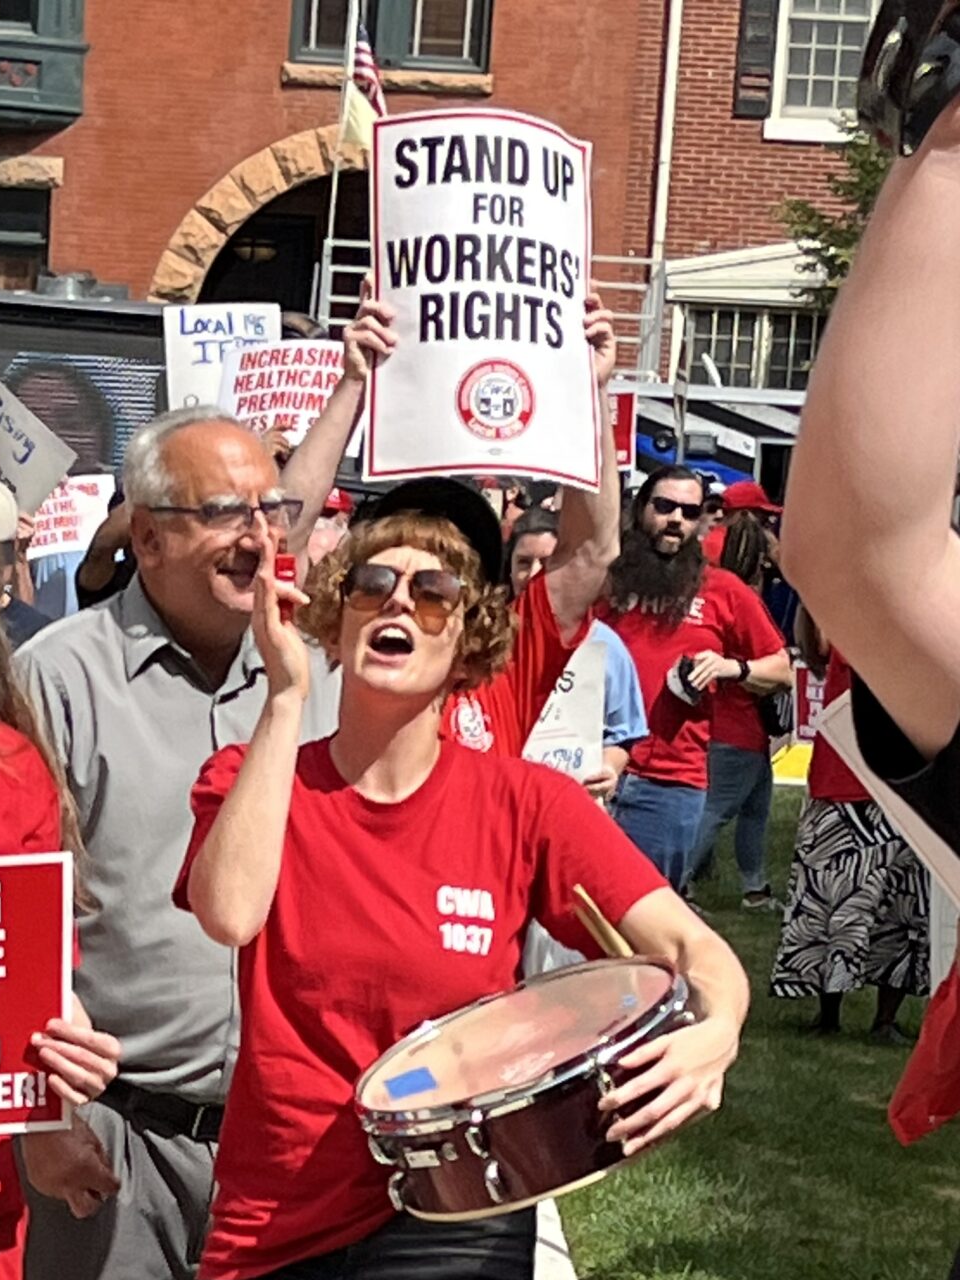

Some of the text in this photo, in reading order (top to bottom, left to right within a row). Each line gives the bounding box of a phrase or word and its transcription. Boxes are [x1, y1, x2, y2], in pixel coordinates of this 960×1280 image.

[394, 135, 574, 202] STAND UP
[472, 192, 525, 227] FOR
[387, 233, 580, 298] WORKERS'
[419, 290, 563, 349] RIGHTS
[239, 348, 345, 371] INCREASIN
[233, 369, 339, 394] HEALTHCAR
[235, 391, 326, 416] PREMIUM
[437, 885, 495, 921] CWA
[439, 922, 493, 956] 1037
